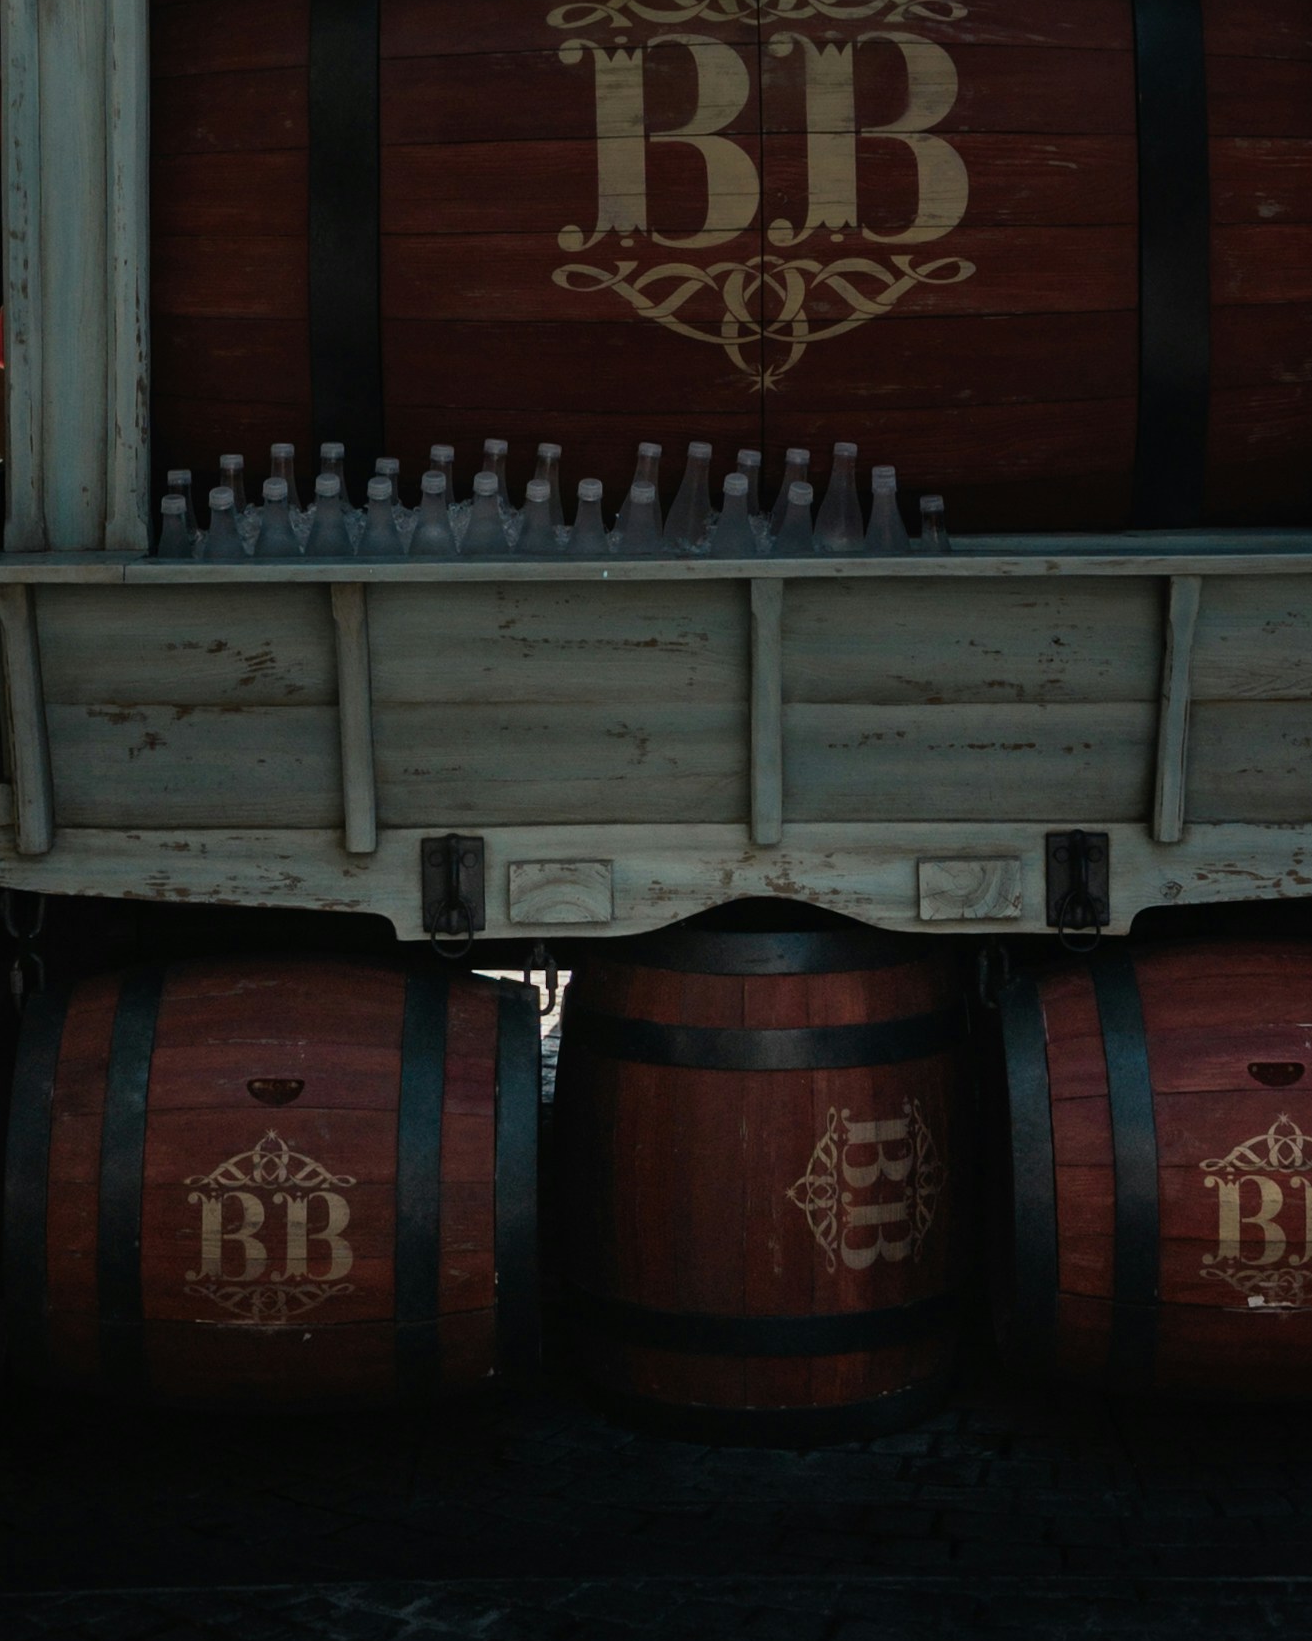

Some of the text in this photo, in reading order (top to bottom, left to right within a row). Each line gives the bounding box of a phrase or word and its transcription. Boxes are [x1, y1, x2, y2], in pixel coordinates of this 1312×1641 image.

[558, 31, 971, 253] BB
[184, 1191, 355, 1284] BB
[840, 1111, 912, 1271] BB
